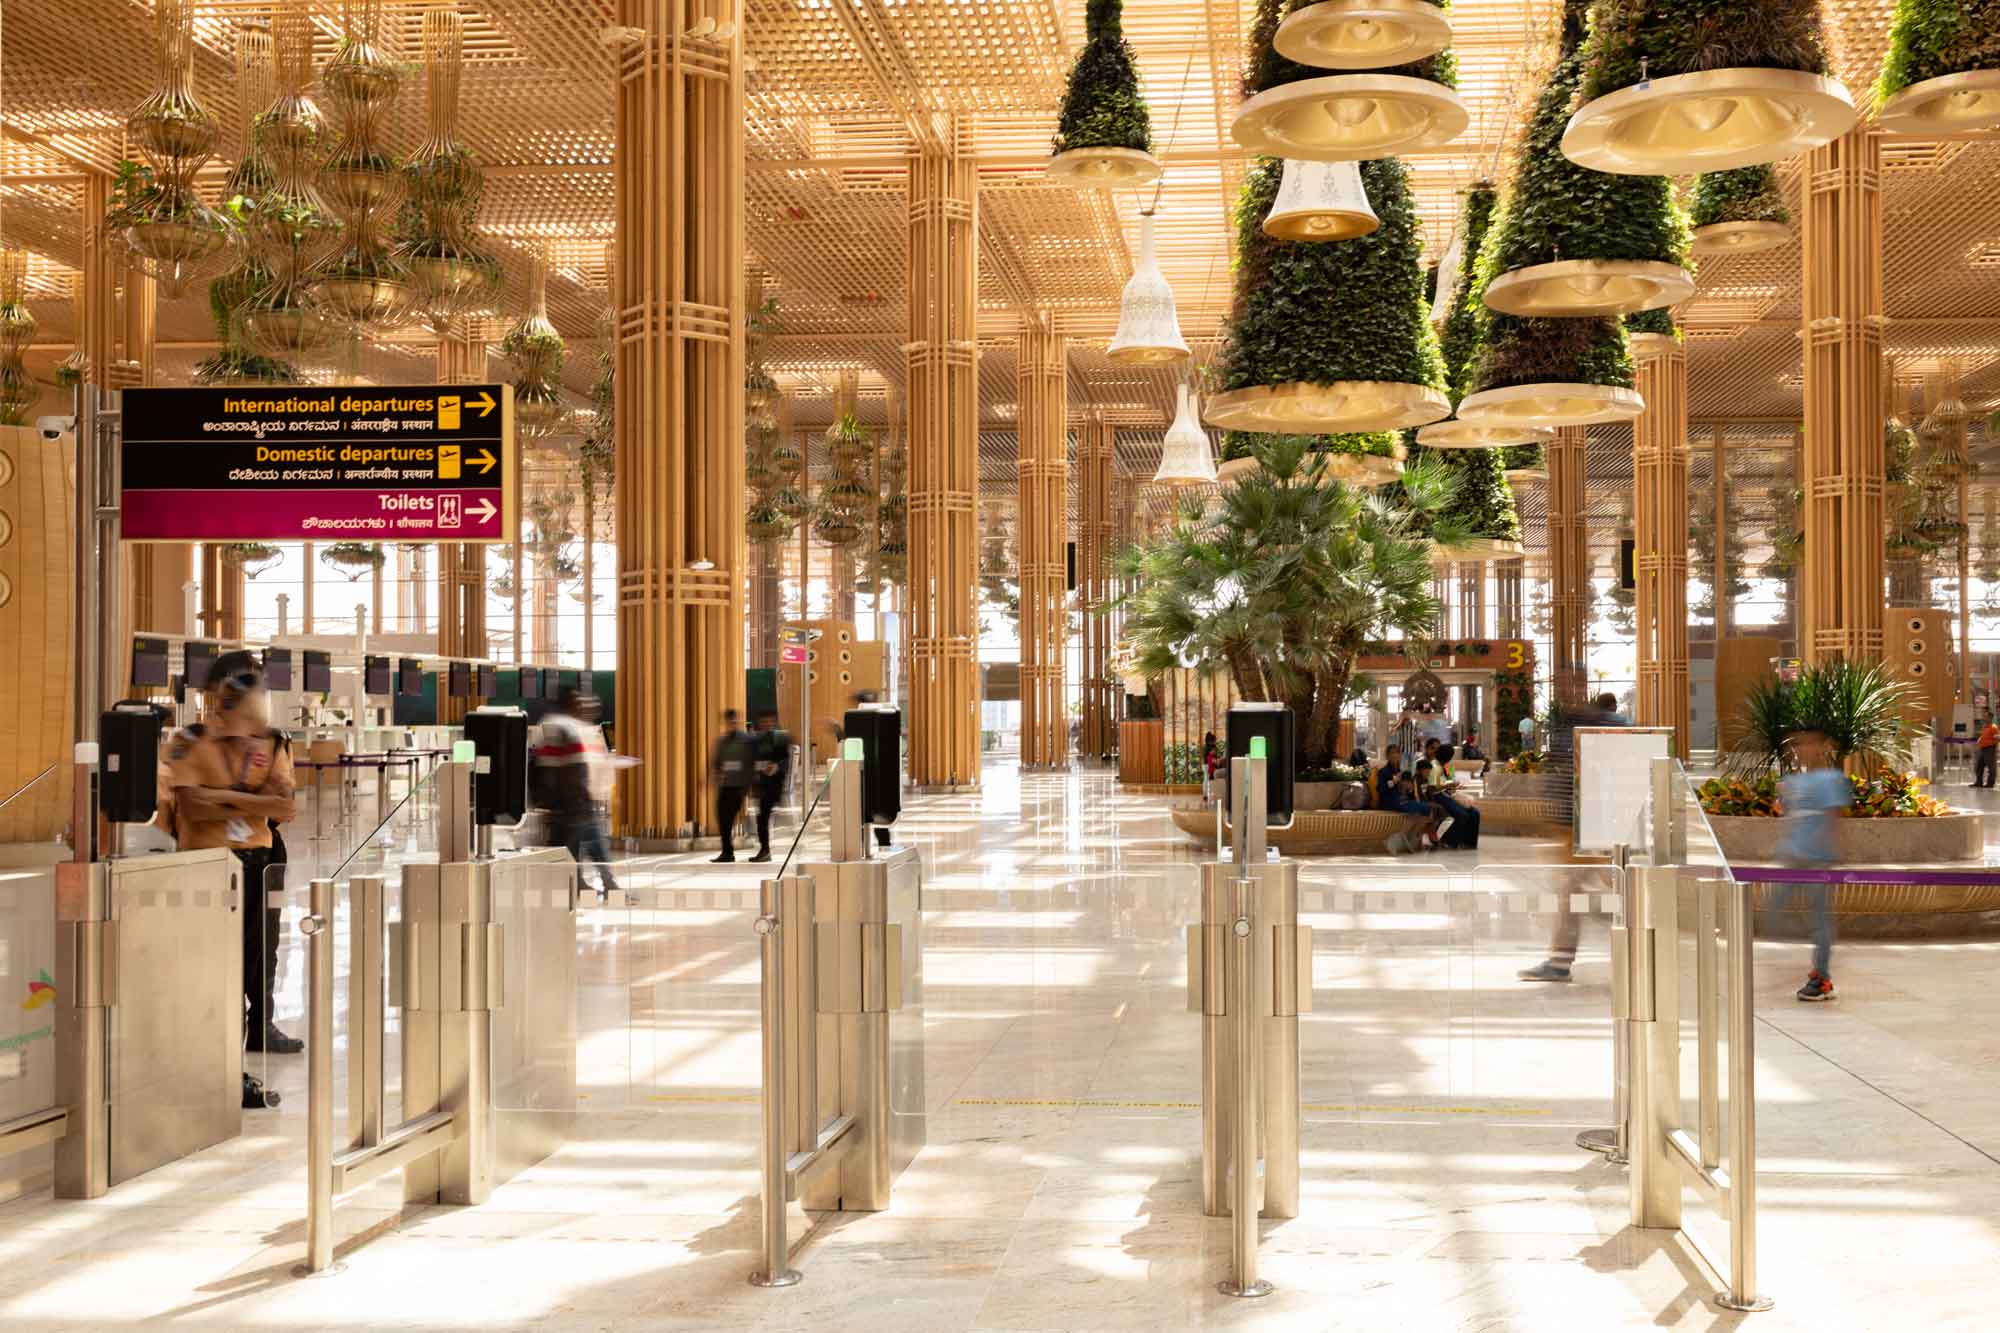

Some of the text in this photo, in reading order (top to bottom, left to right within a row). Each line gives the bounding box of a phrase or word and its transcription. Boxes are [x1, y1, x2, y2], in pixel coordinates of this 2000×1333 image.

[224, 395, 434, 416] International departures
[288, 419, 340, 432] ನಿರ್ಗಮನ
[401, 420, 434, 431] प्रस्थान
[256, 444, 434, 464] Domestic departures
[228, 467, 334, 481] ದೇಶೀಯ ನಿರ್ಗಮನ
[401, 469, 434, 480] प्रस्थान
[377, 493, 435, 509] Toilets
[1507, 642, 1524, 668] 3
